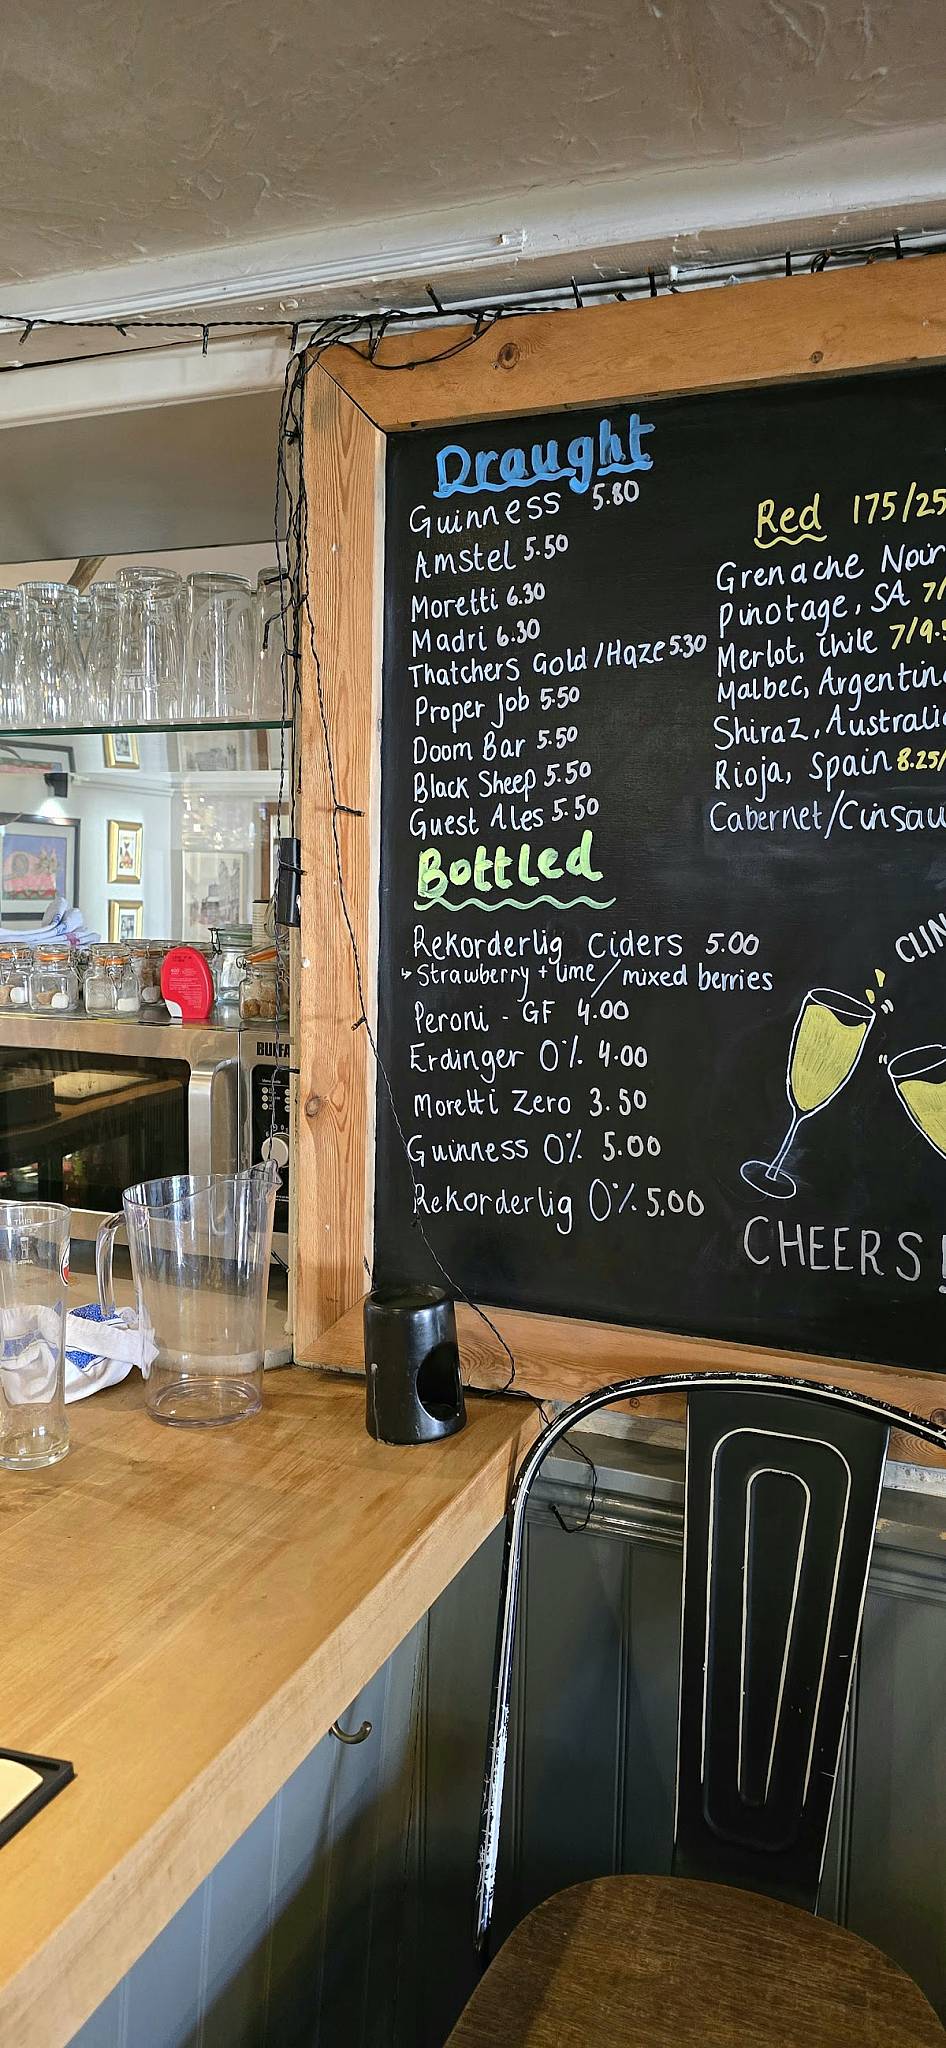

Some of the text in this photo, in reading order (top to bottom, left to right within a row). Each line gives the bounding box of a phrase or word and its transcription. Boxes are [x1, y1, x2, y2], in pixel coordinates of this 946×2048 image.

[436, 413, 655, 494] Draught
[409, 480, 640, 538] Guinness 5.80
[757, 493, 822, 538] Red
[415, 534, 568, 583] Amstel 5.50
[716, 543, 946, 593] Grenache Noir
[411, 582, 545, 622] Moretti 6.30
[870, 579, 911, 612] SA
[412, 618, 540, 657] Madri 6.30
[717, 636, 804, 677] Merlot,
[408, 658, 520, 688] Thatchers
[669, 634, 707, 659] 5.30
[415, 696, 485, 733] Proper
[540, 686, 580, 710] 5.50
[717, 675, 810, 710] Malbec,
[414, 726, 578, 764] Doom Bar 5.50
[414, 760, 592, 803] Black Sheep 5.50
[715, 756, 791, 802] Rioja,
[808, 748, 892, 792] Spain
[410, 794, 599, 840] Guest Ales 5.50
[418, 830, 604, 898] Bottled
[413, 925, 760, 964] Rekorderlig Ciders 5.00
[416, 962, 530, 1002] Strawberry
[622, 963, 688, 987] mixed
[698, 962, 773, 991] berries
[414, 1000, 489, 1033] Peroni
[522, 1000, 556, 1024] GF
[577, 998, 629, 1026] 4.00
[410, 1043, 524, 1083] Erdinger
[598, 1040, 648, 1068] 4.00
[414, 1087, 647, 1118] Moretti Zero 3.50
[407, 1135, 529, 1168] Guinness
[602, 1131, 661, 1161] 5.00
[413, 1183, 573, 1235] Rekorderlig
[646, 1187, 705, 1217] 5.00
